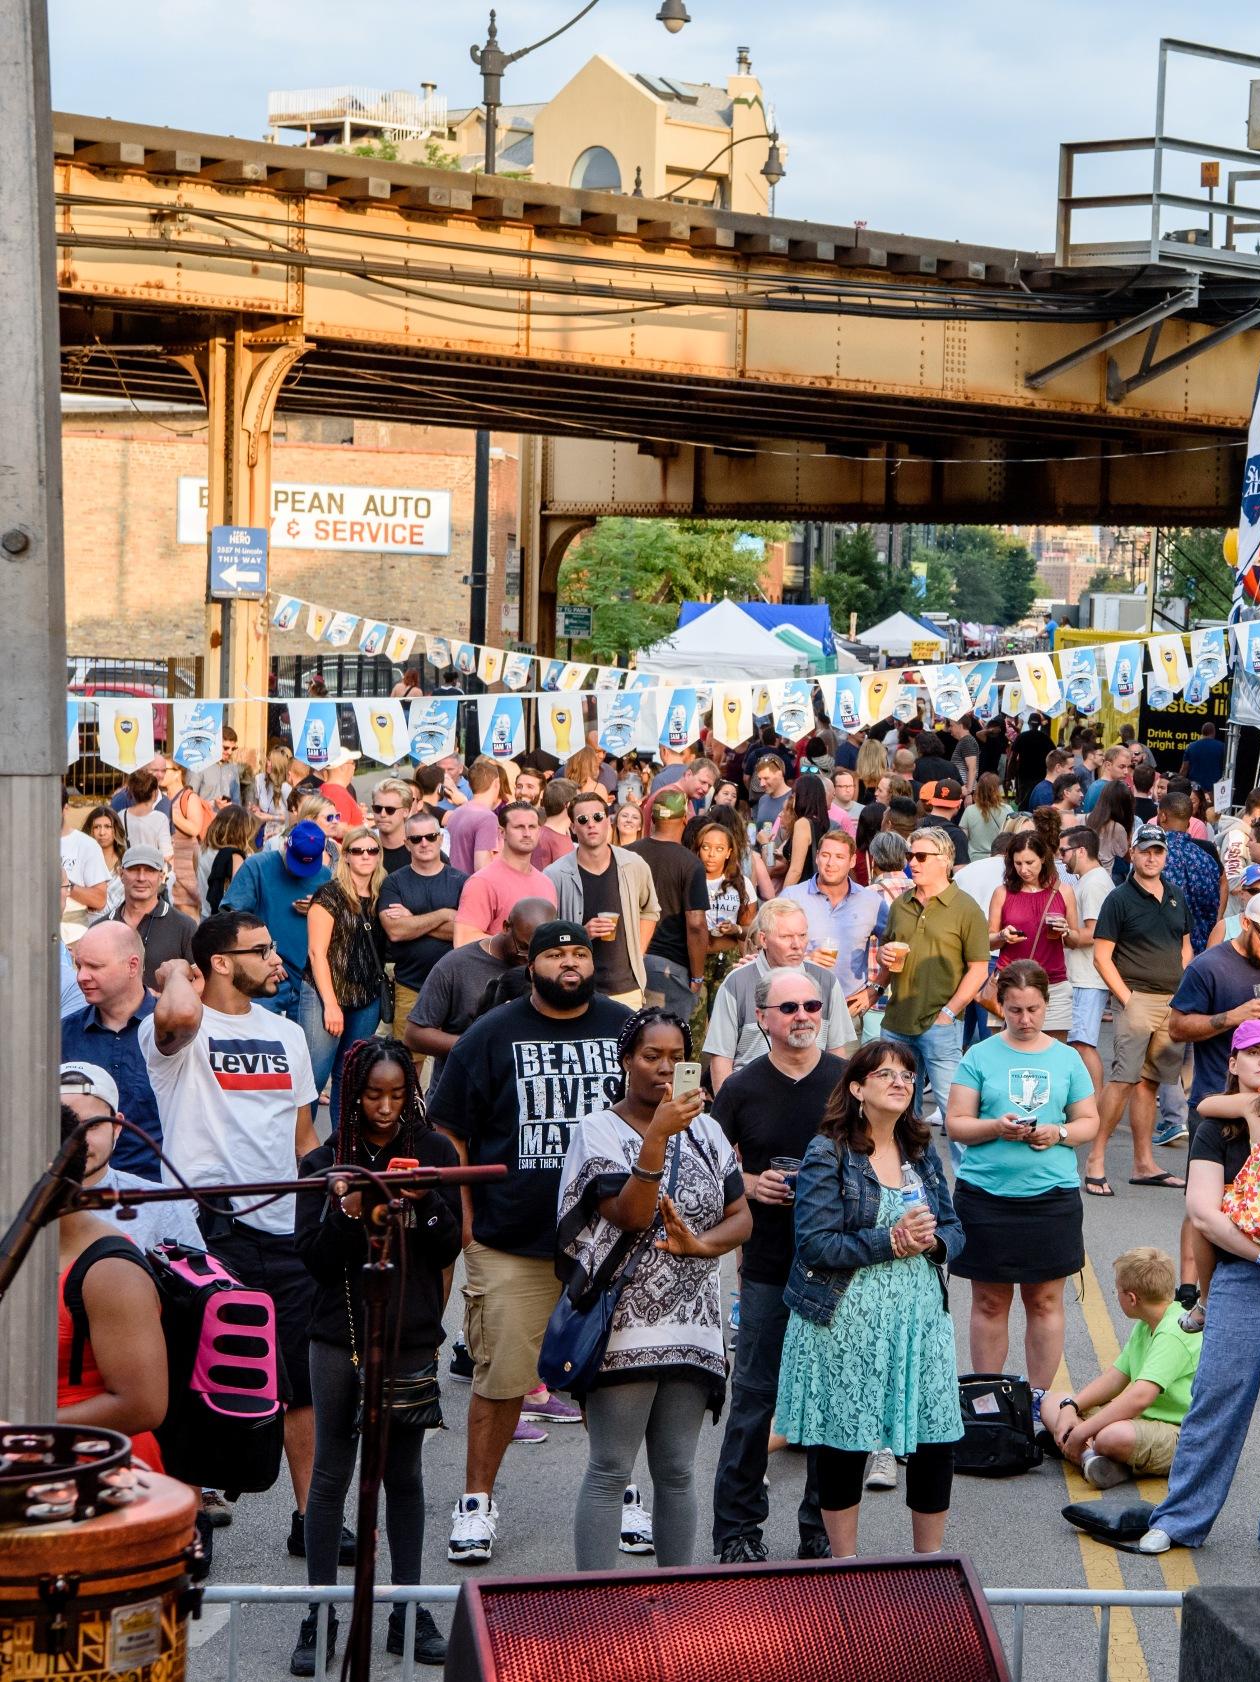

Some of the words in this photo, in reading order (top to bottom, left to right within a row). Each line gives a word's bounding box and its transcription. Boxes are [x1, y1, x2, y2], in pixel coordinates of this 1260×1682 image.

[199, 486, 344, 515] EPEAN
[363, 494, 431, 519] AUTO
[229, 534, 251, 545] HERO
[287, 518, 300, 539] &
[315, 520, 424, 546] SERVICE
[1147, 728, 1173, 739] Drink
[1175, 732, 1188, 740] on
[1147, 739, 1175, 751] bright
[520, 1041, 621, 1077] BEARD
[525, 1076, 621, 1120] LIVES
[523, 1123, 580, 1155] MAT
